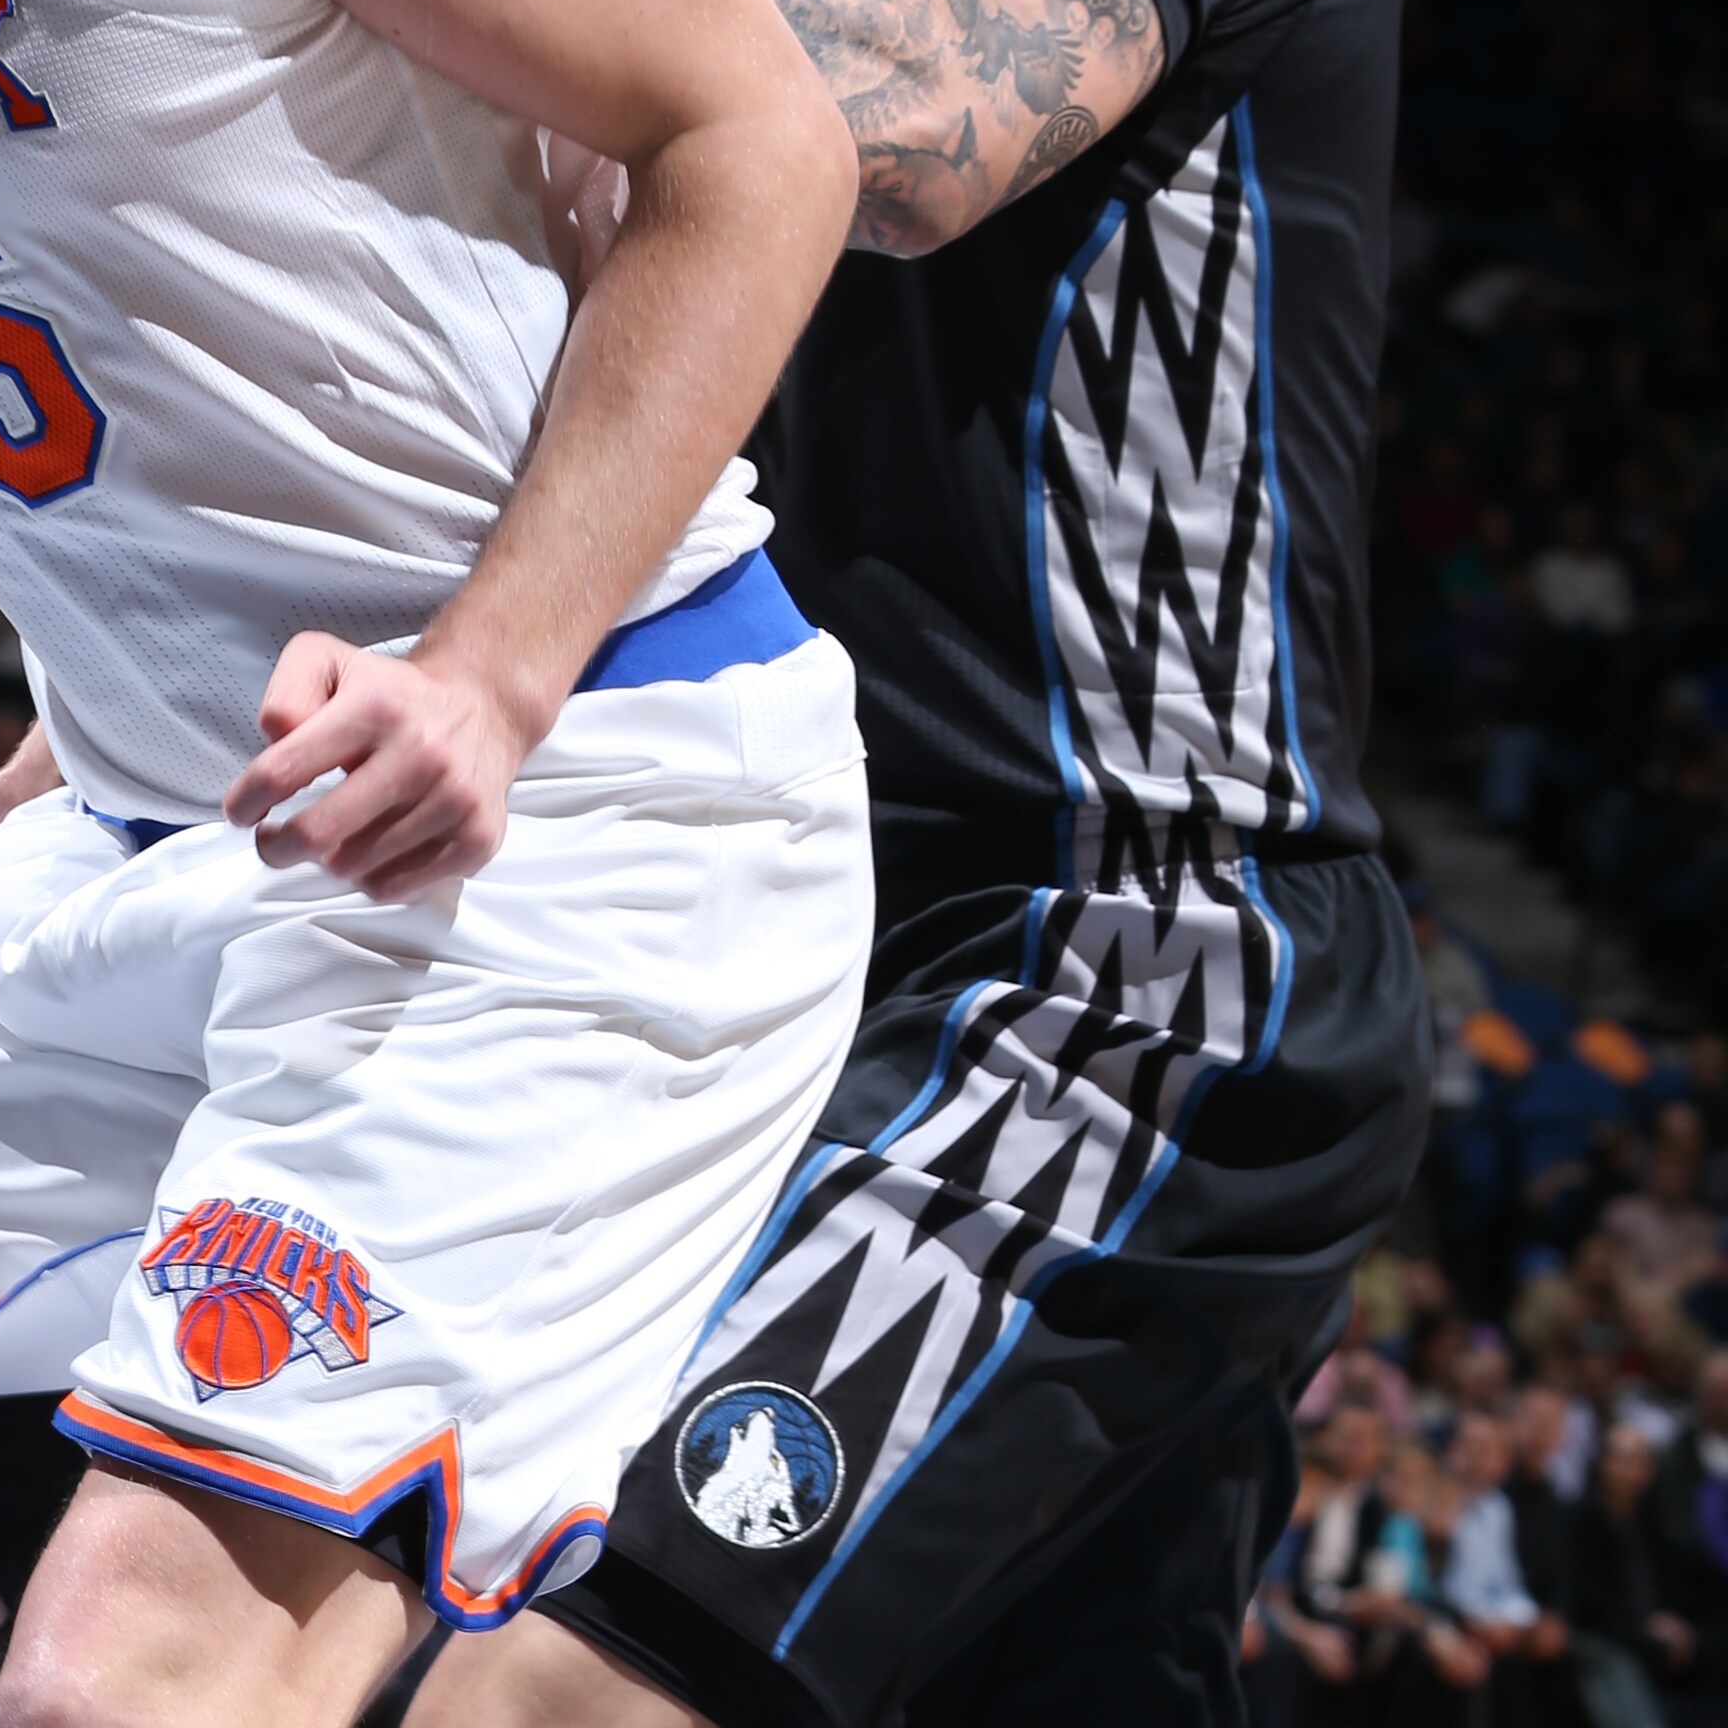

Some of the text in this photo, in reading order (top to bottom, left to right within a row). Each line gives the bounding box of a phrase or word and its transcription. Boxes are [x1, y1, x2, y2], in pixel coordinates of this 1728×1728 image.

[237, 1196, 338, 1249] NEW YORK
[139, 1198, 369, 1364] KNICKS
